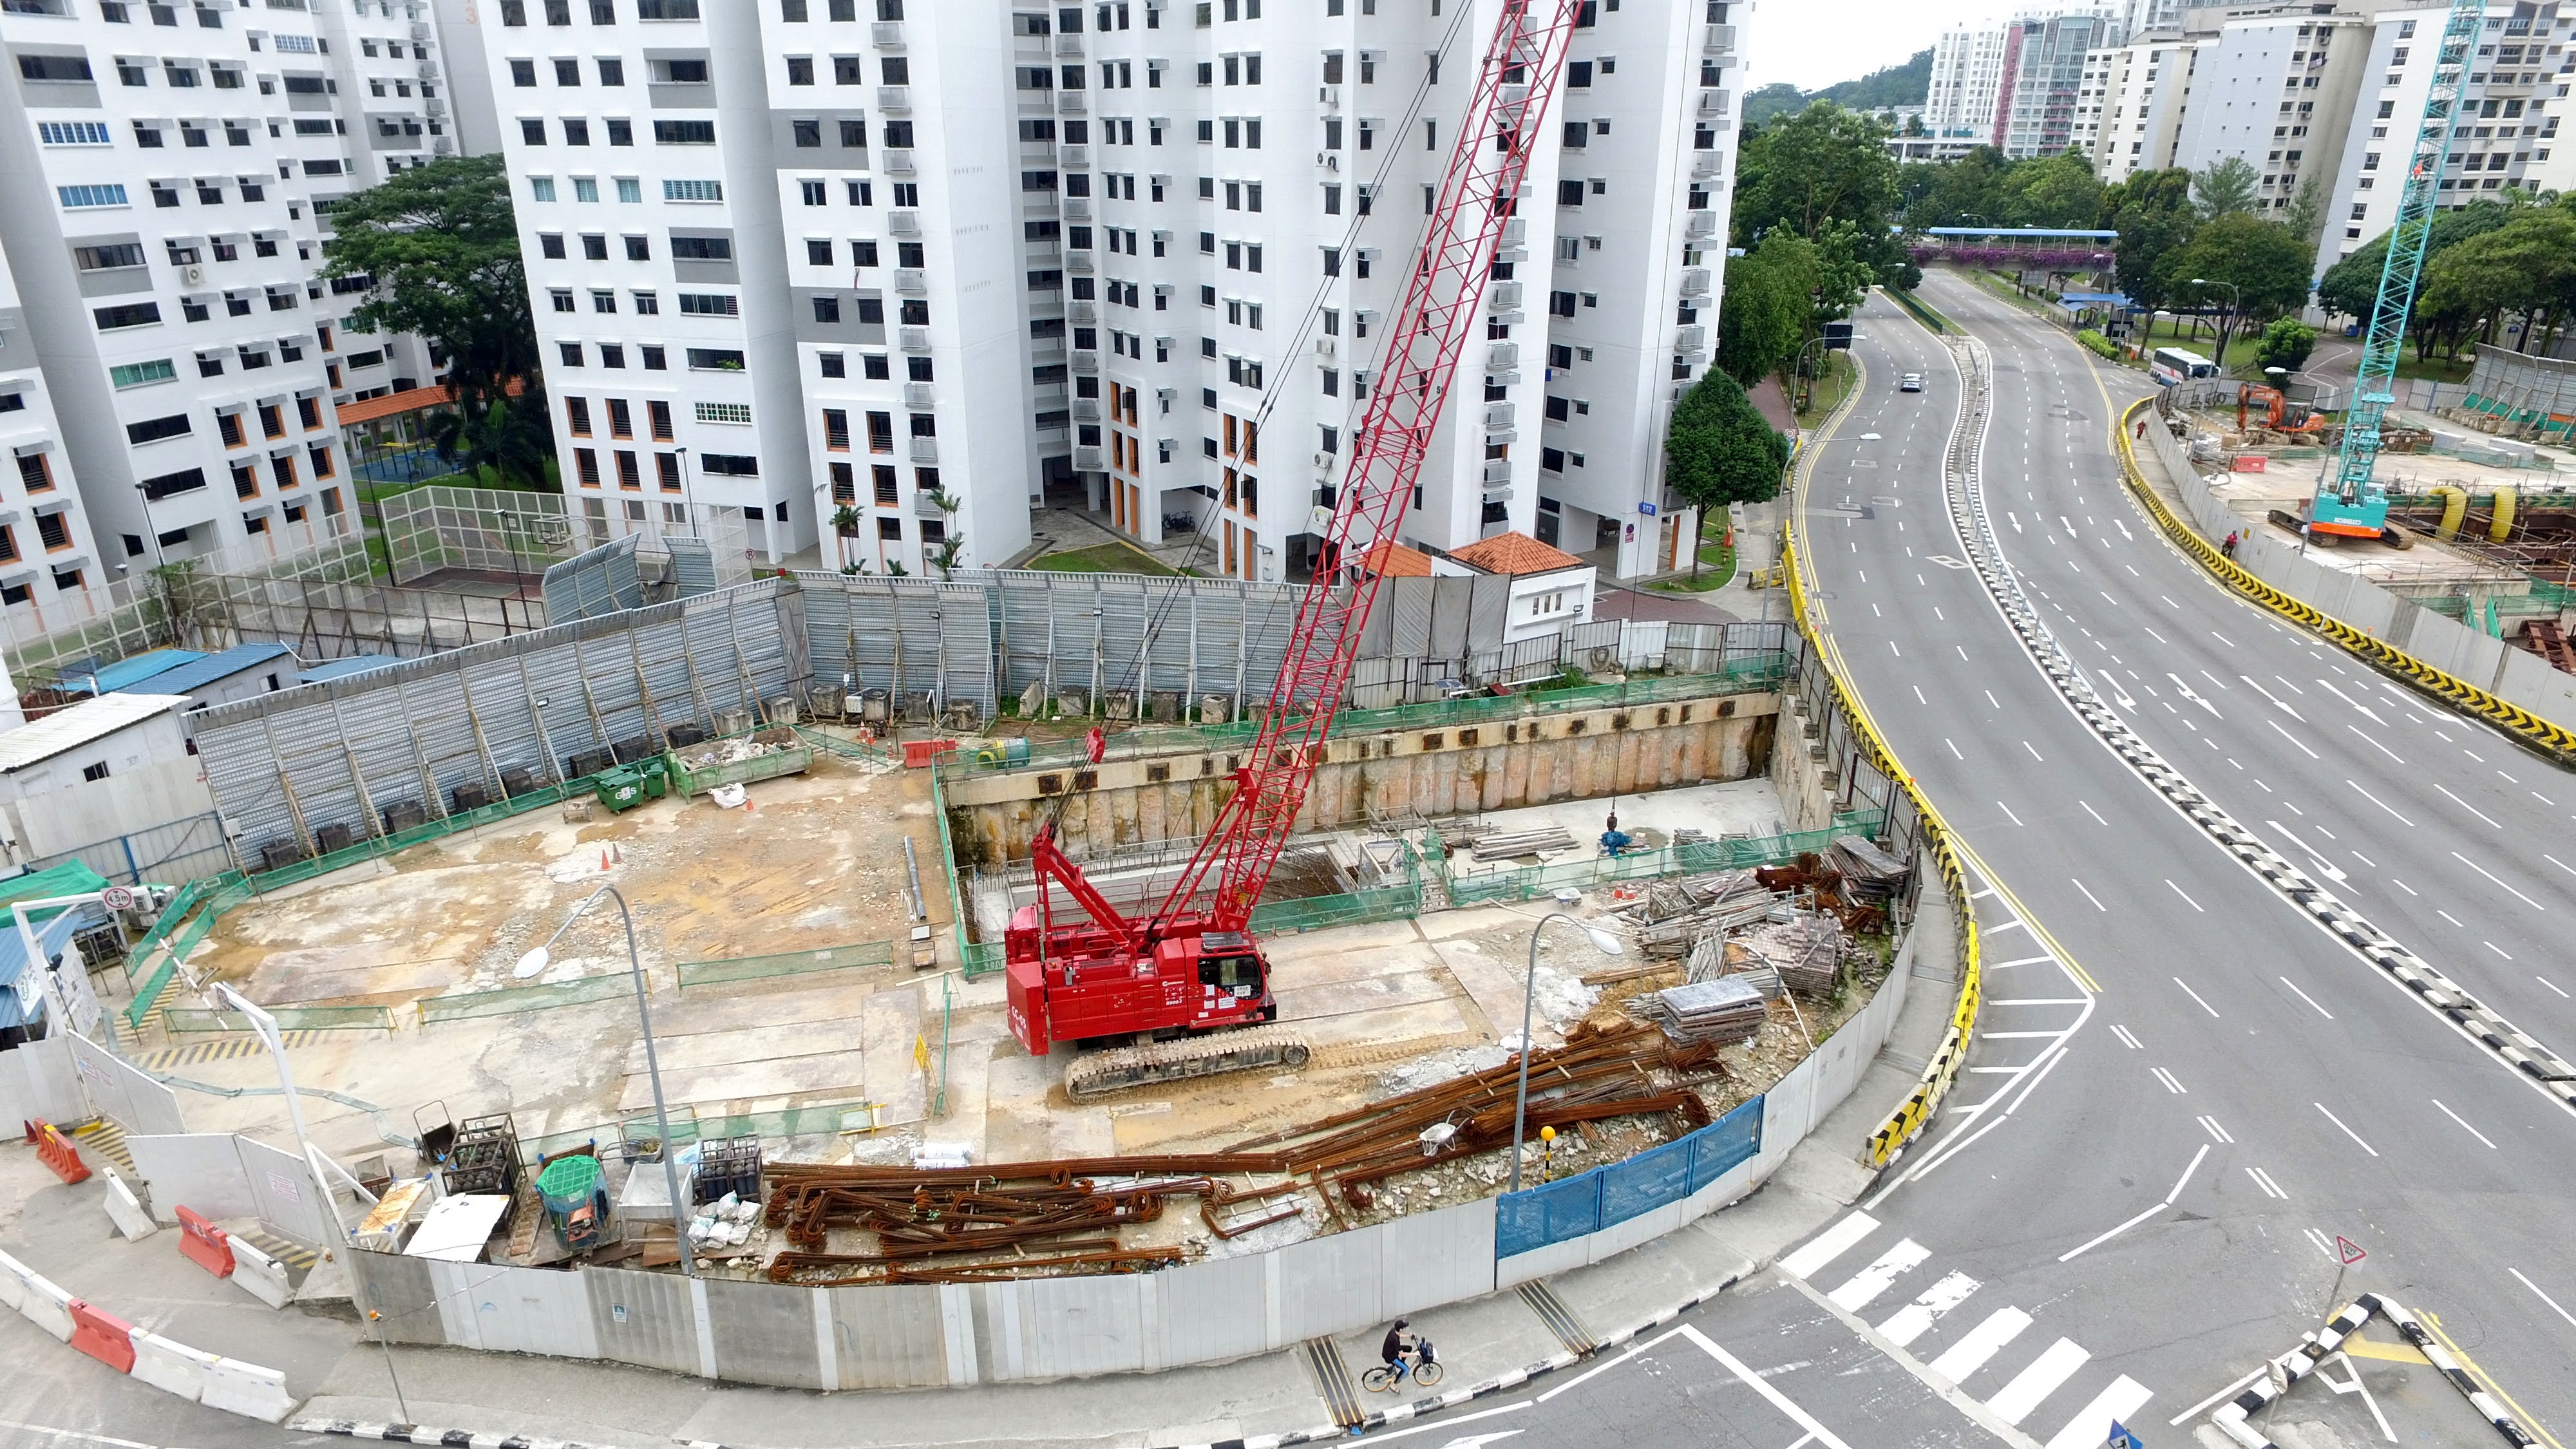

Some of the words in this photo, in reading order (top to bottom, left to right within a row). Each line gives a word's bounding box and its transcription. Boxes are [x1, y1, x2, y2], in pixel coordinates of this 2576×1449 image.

[1642, 504, 1653, 513] 512
[615, 787, 637, 800] GS
[2343, 1243, 2358, 1255] GIVE
